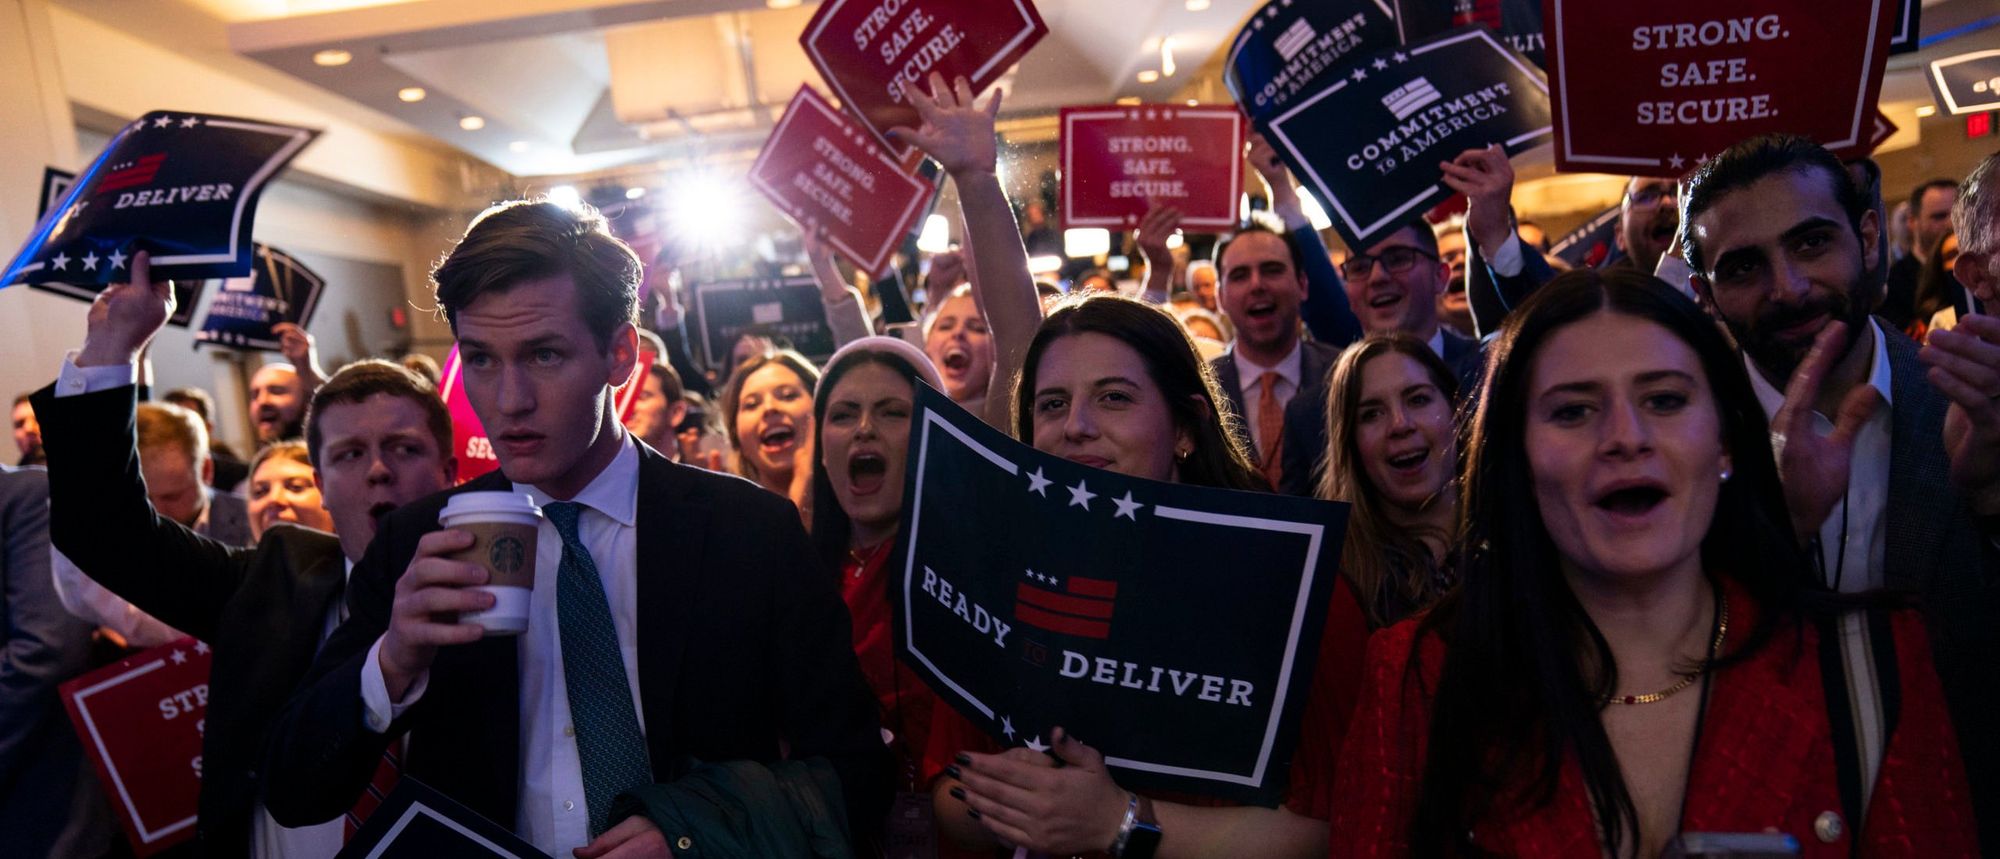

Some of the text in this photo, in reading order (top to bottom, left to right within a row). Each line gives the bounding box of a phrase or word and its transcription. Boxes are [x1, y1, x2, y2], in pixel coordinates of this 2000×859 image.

[854, 0, 908, 51] STRO
[881, 8, 934, 65] SAFE.
[1632, 14, 1790, 50] STRONG.
[887, 25, 965, 104] SECURE.
[1255, 12, 1367, 106] COMMITMENT
[1288, 33, 1362, 95] AMERICA
[1660, 58, 1756, 87] SAFE.
[1347, 82, 1511, 170] COMMITMENT
[1637, 94, 1779, 124] SECURE.
[1108, 136, 1193, 153] STRONG.
[1376, 102, 1507, 174] TO AMERICA
[813, 136, 875, 193] STRONG.
[813, 163, 853, 201] SAFE.
[1109, 181, 1189, 198] SECURE.
[1123, 159, 1176, 175] SAFE.
[113, 183, 234, 209] DELIVER
[794, 172, 853, 226] SECURE.
[922, 565, 1012, 649] READY
[1059, 650, 1255, 706] DELIVER
